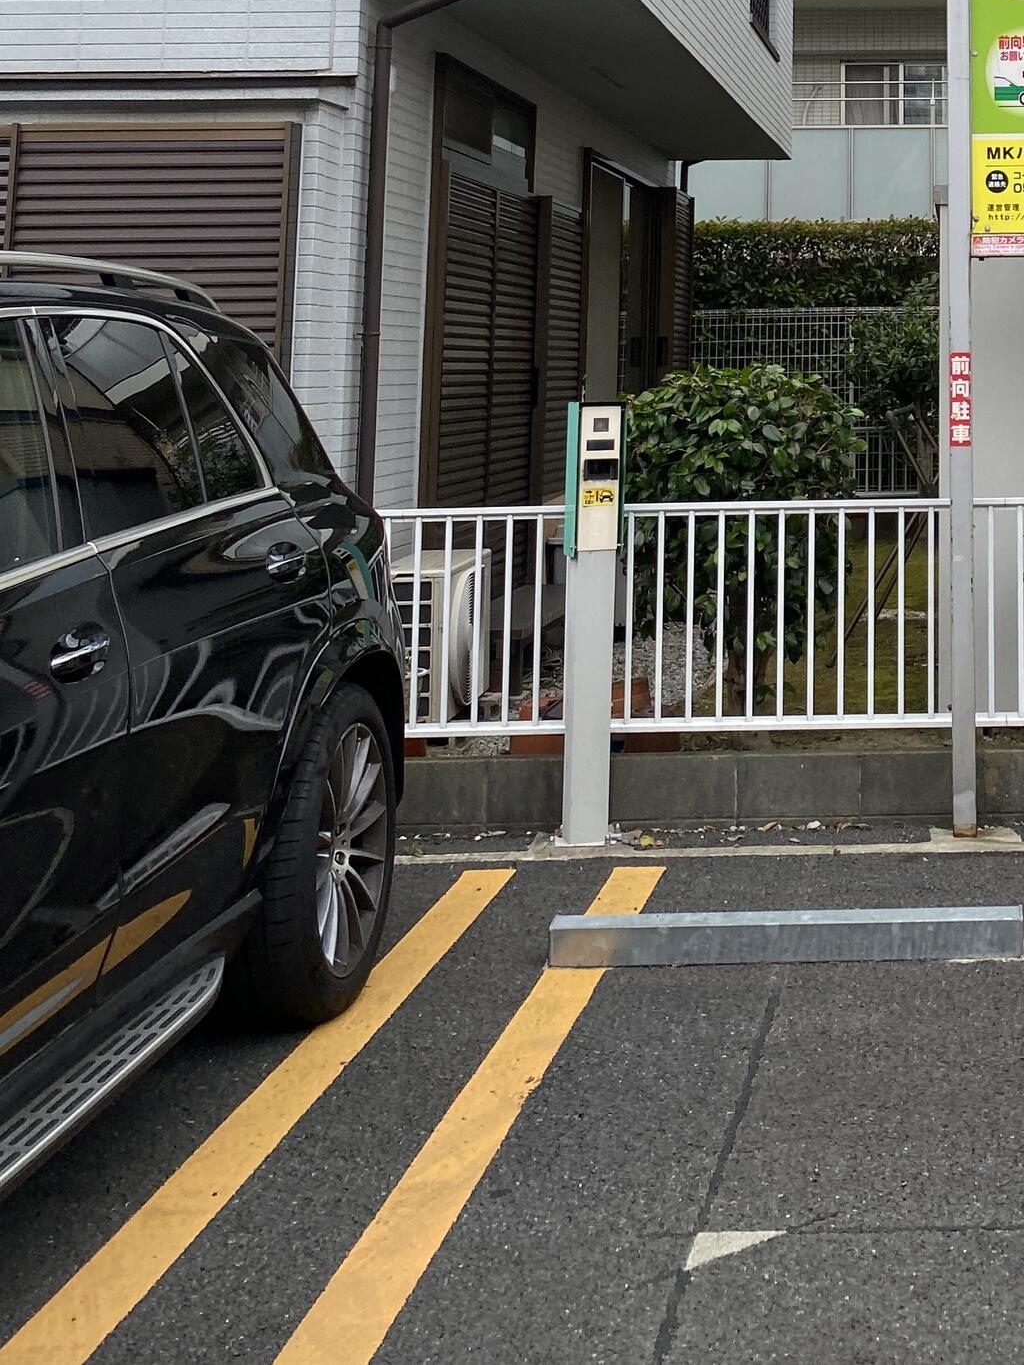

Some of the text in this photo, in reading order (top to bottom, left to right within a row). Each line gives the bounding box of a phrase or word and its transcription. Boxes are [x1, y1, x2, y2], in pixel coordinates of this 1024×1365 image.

[987, 203, 1020, 212] 運営管理
[951, 355, 971, 444] 前向駐車
